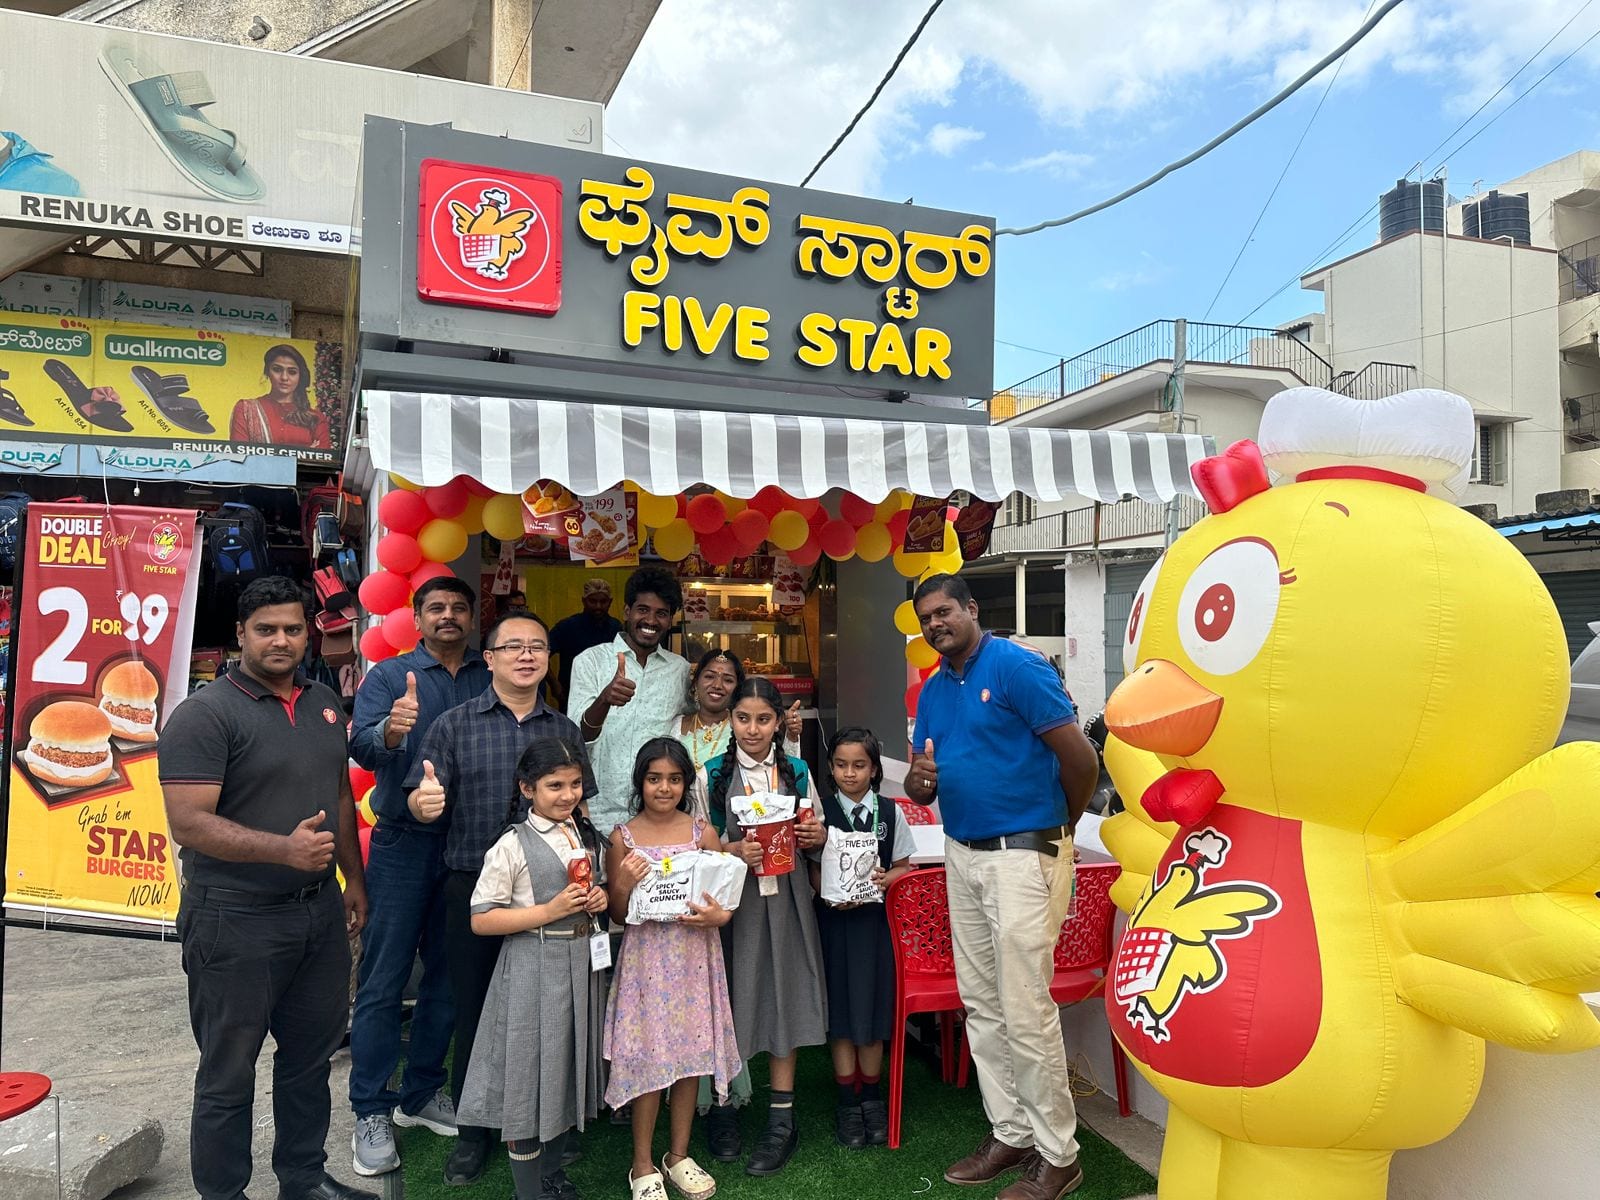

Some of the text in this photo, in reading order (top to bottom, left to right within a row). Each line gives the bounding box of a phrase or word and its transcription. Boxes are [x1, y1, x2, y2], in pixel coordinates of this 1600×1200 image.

[20, 195, 244, 238] RENUKA SHOE
[252, 222, 342, 243] ರೇಣುಕಾ ಶೂ
[577, 166, 992, 320] ಫೈವ್ ಸ್ಟಾರ್
[112, 290, 194, 313] ALDURA
[201, 299, 278, 322] ALDURA
[624, 290, 952, 380] FIVE STAR
[109, 340, 223, 361] walkmate
[55, 397, 87, 430] Art No. 854
[138, 400, 171, 433] Art No. 6051
[104, 448, 192, 469] ALDURA
[172, 442, 333, 461] RENUKA SHOE CENTER
[40, 517, 103, 536] DOUBLE
[566, 522, 579, 531] 60
[39, 536, 107, 565] DEAL
[143, 564, 177, 575] FIVE STAR
[31, 586, 89, 685] 2
[91, 618, 122, 636] FOR
[78, 804, 108, 832] Grab
[87, 825, 167, 864] STAR
[845, 840, 861, 848] FIVE
[86, 857, 165, 882] BURGERS
[127, 882, 172, 908] NOW!
[655, 882, 675, 890] SPICY
[850, 888, 880, 901] CRUNCHY
[855, 881, 869, 889] SPICY
[859, 885, 874, 893] SAUCY
[649, 893, 687, 903] CRUNCHY
